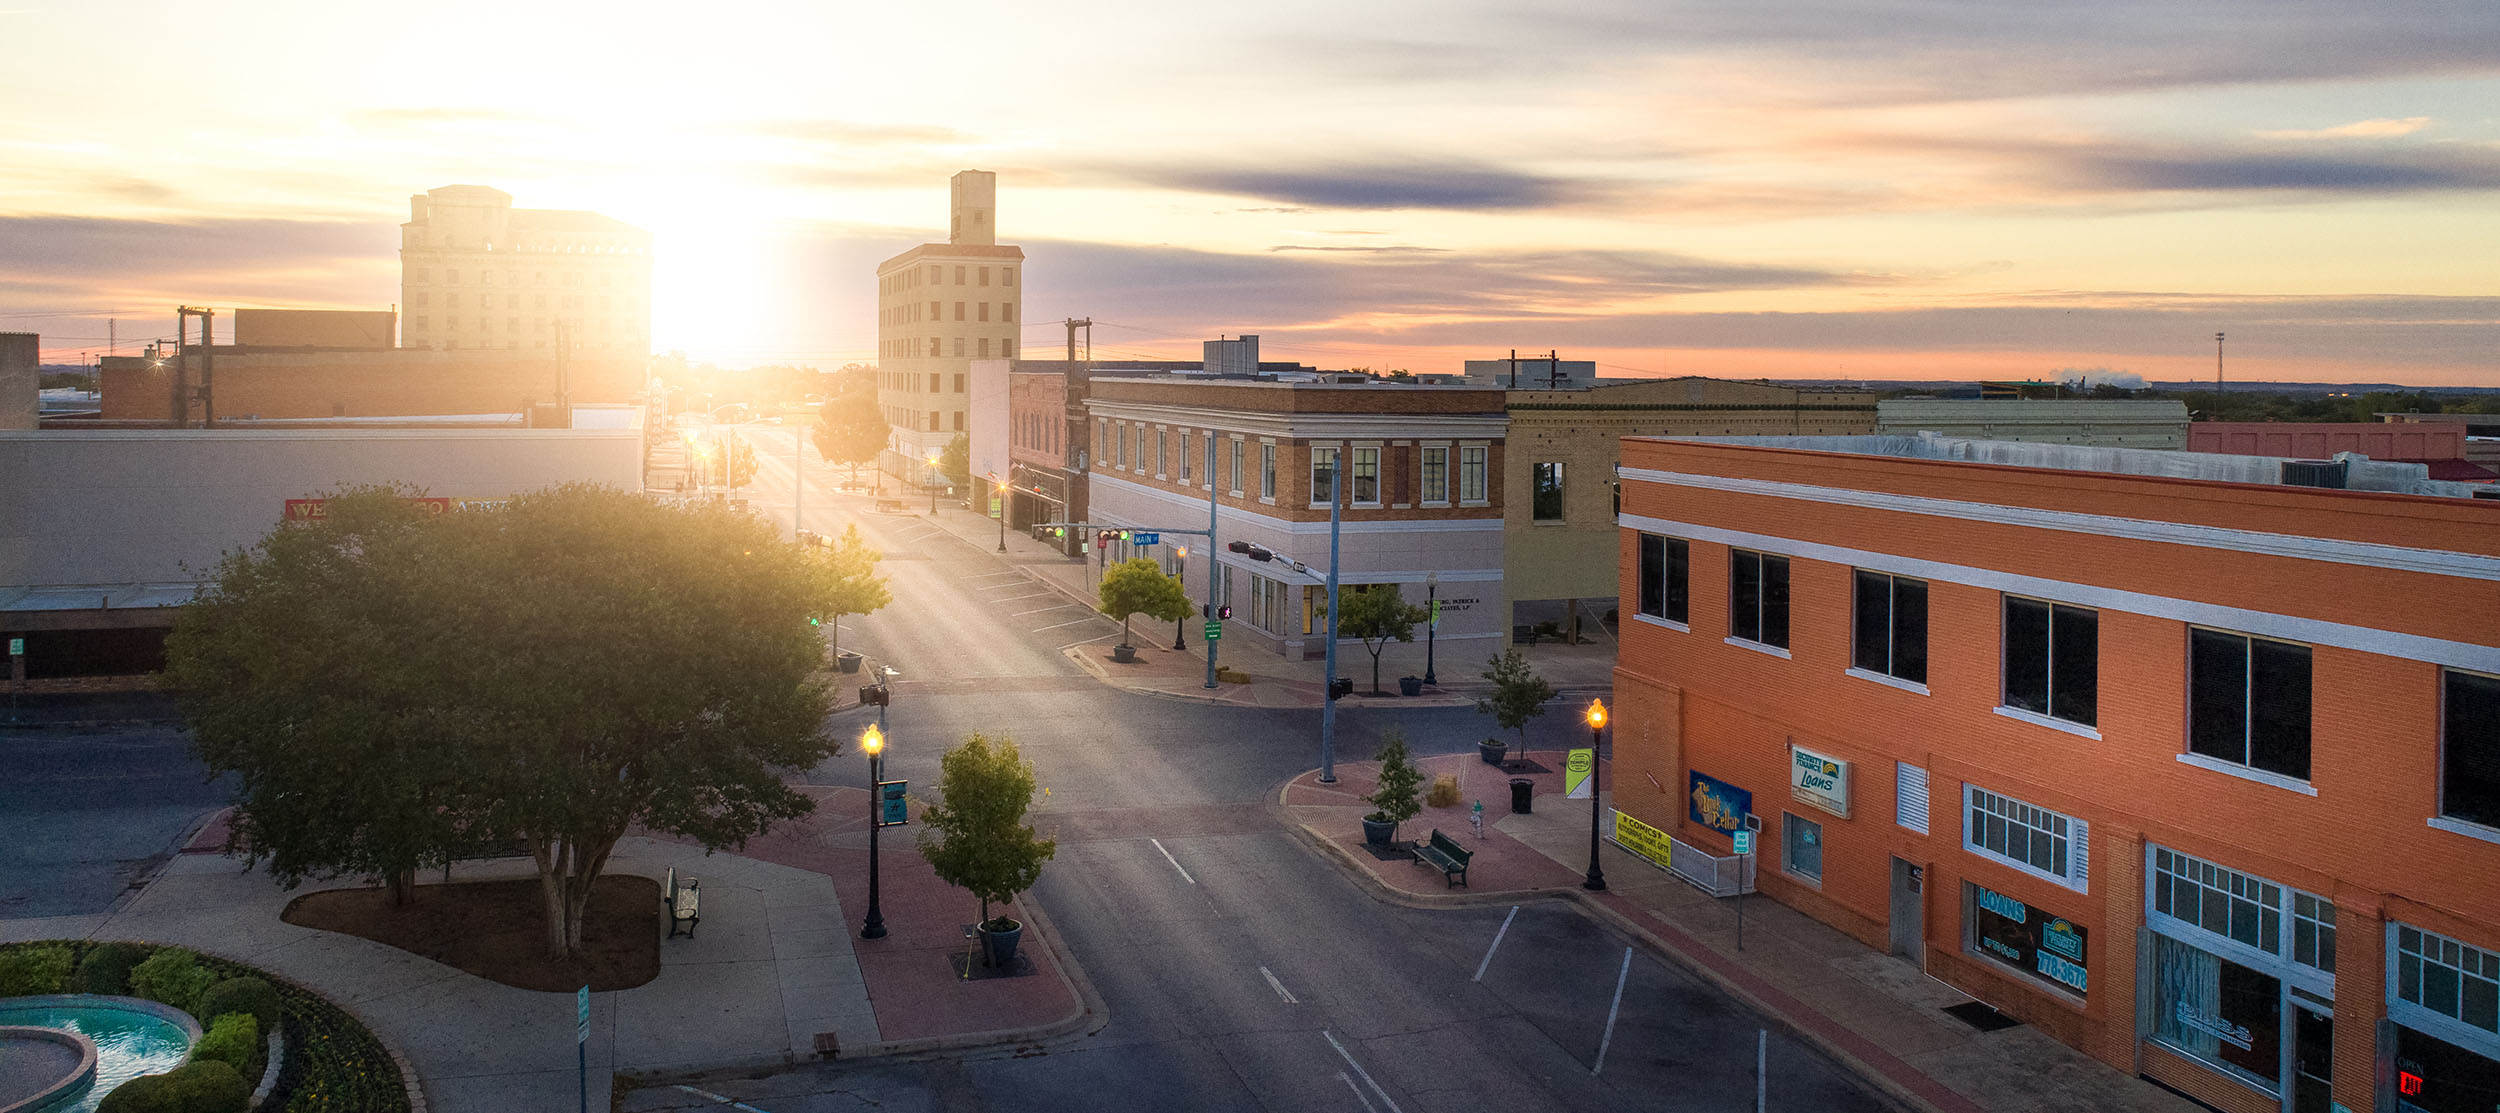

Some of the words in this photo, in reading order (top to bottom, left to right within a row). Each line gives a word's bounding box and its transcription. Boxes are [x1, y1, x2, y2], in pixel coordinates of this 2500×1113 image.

[1135, 536, 1152, 544] MAIN
[1796, 750, 1822, 766] SECURITY
[1697, 782, 1710, 793] The
[1800, 770, 1833, 790] Loans
[1703, 794, 1721, 812] Book
[1712, 808, 1740, 830] Cellar
[1629, 820, 1657, 838] COMICS
[1980, 887, 2026, 924] LOANS
[2036, 949, 2087, 992] 778-3678
[2397, 1056, 2424, 1075] OPEN
